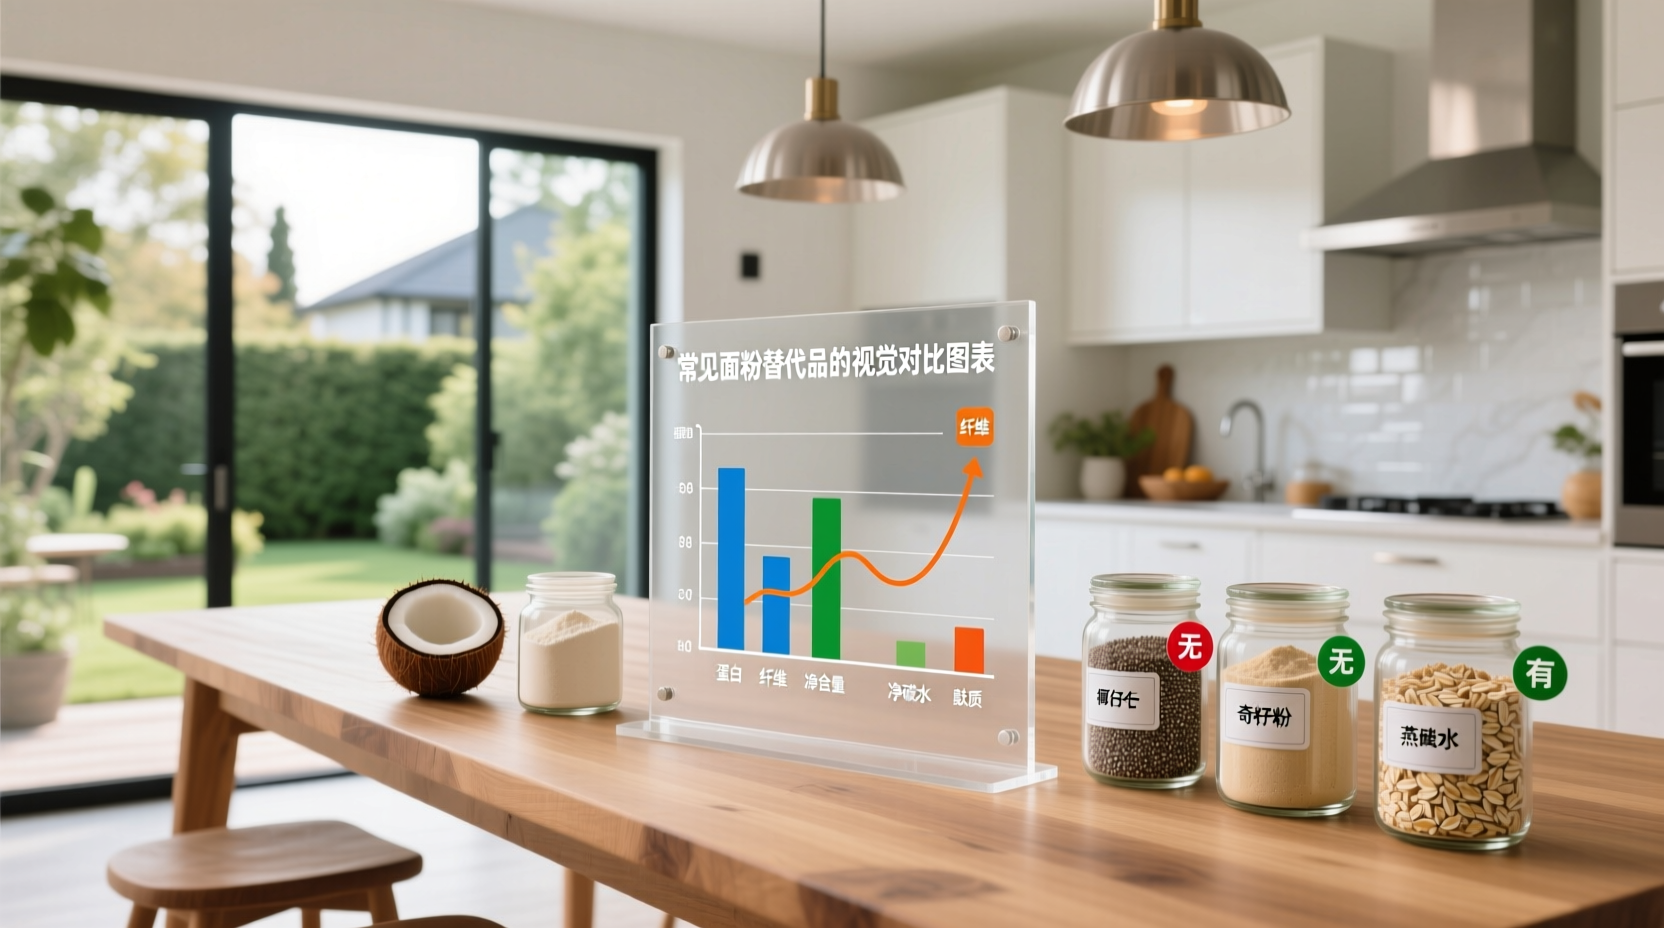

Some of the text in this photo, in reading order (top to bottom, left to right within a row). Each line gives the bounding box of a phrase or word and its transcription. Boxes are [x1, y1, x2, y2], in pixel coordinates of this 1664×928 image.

[677, 341, 996, 383] 常见面粉替代品的视觉对比图表
[1178, 633, 1203, 660] 无
[716, 663, 742, 683] 蛋白
[1328, 648, 1354, 675] 无
[1525, 657, 1555, 689] 有
